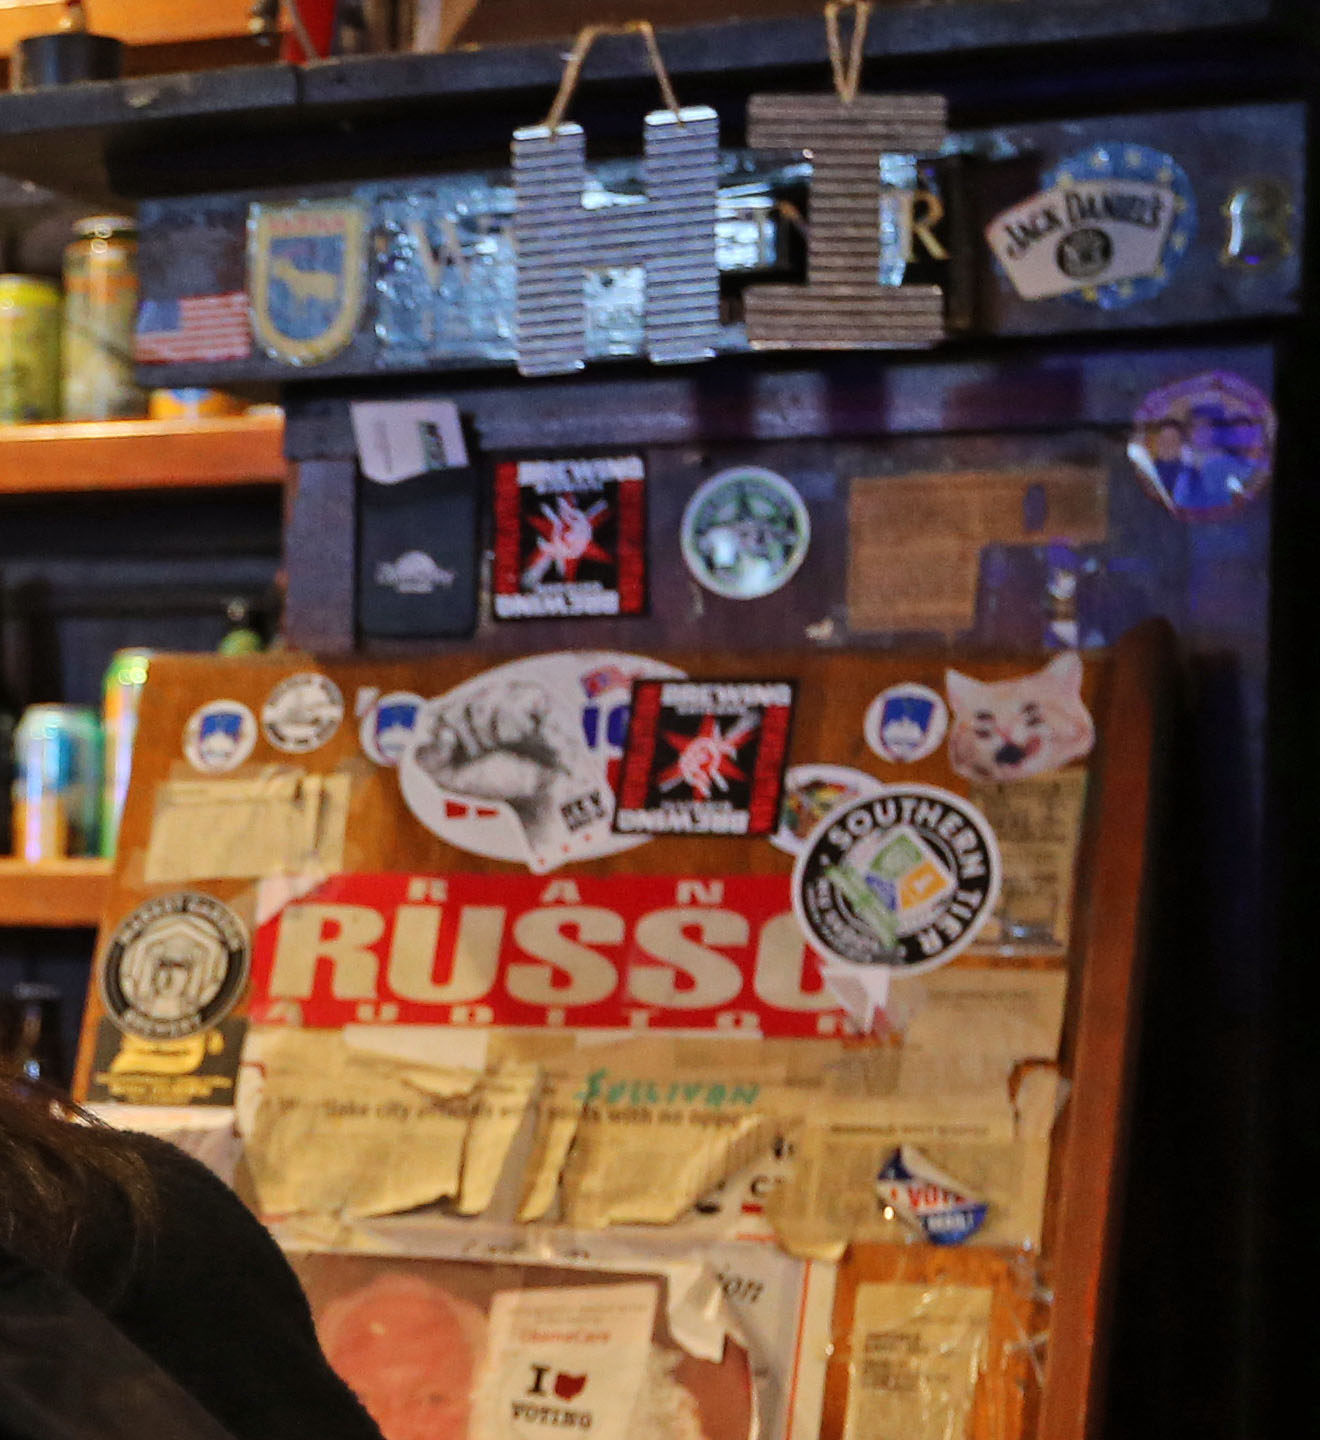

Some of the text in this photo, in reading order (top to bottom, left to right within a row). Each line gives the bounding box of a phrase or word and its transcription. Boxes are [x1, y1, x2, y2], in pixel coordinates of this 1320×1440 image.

[826, 798, 988, 880] SOUTHERN
[918, 888, 984, 955] TIER
[526, 1362, 552, 1396] I
[512, 1402, 594, 1430] VOTING
